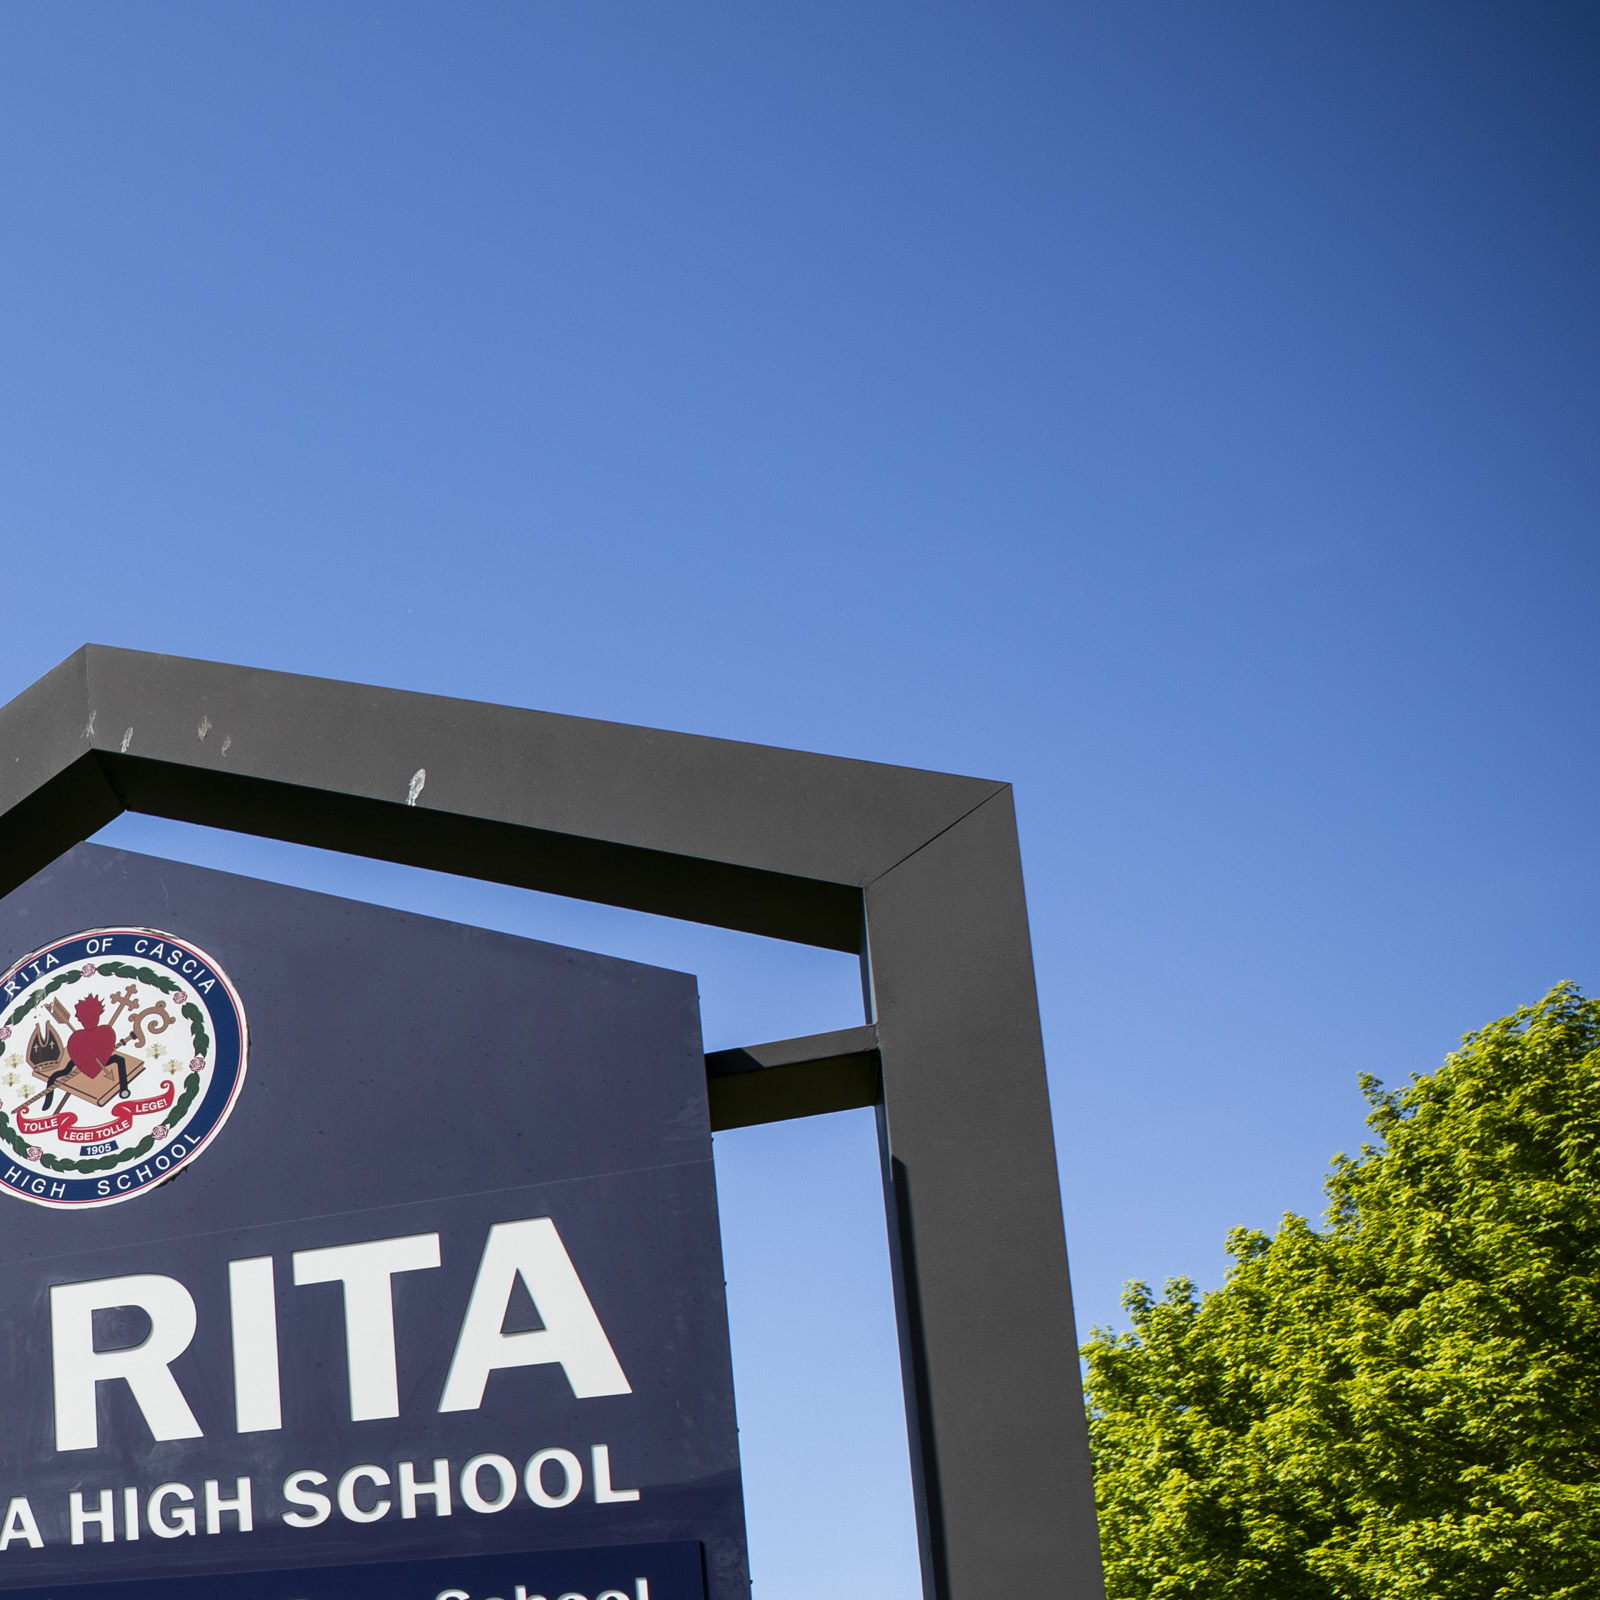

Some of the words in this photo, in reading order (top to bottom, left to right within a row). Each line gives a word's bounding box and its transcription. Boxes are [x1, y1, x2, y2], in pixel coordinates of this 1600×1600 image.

[3, 953, 60, 997] RITA
[86, 938, 113, 954] OF
[134, 939, 216, 994] CASCIA
[23, 1117, 59, 1132] TOLLE
[63, 1127, 94, 1141] LEGE!
[97, 1119, 131, 1139] TOLLE
[135, 1098, 168, 1113] LEGE!
[86, 1144, 112, 1155] 1905
[3, 1165, 66, 1198] HIGH
[97, 1133, 201, 1195] SCHOOL
[48, 1216, 633, 1453] RITA
[69, 1475, 254, 1545] HIGH
[280, 1443, 641, 1529] SCHOOL
